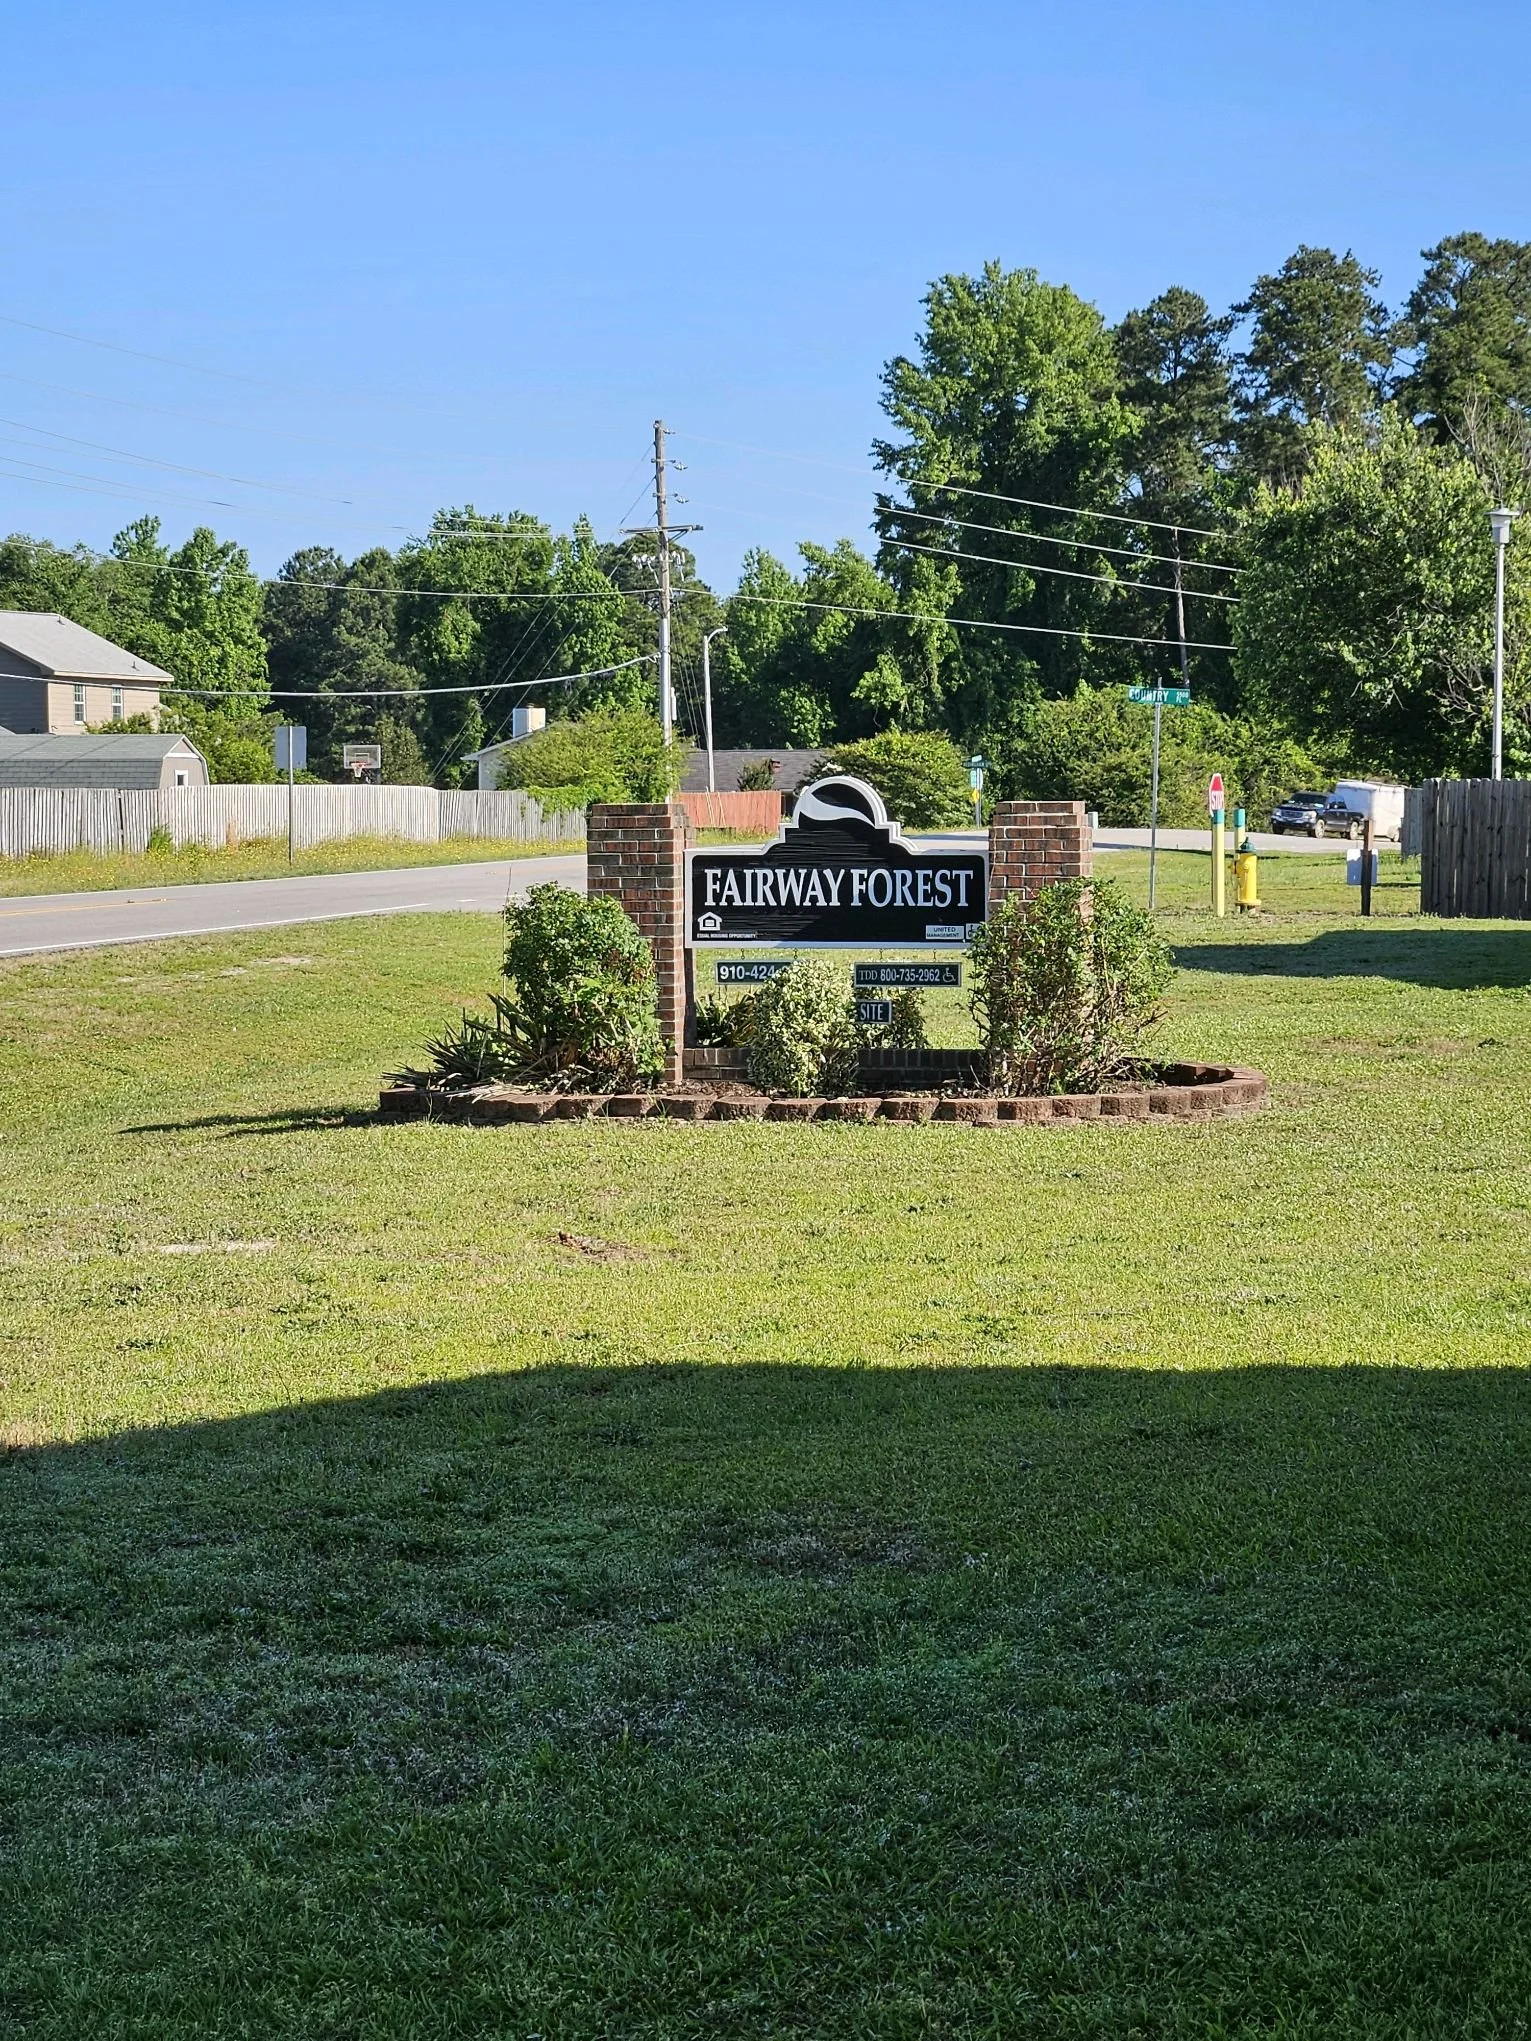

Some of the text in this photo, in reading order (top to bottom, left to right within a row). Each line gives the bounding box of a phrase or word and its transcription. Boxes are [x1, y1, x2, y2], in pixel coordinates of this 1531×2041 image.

[1128, 688, 1169, 702] COUNTRY
[704, 868, 974, 907] FAIRWAY FOREST
[858, 968, 941, 982] TDD 800-735-2962
[860, 1003, 884, 1021] SITE
